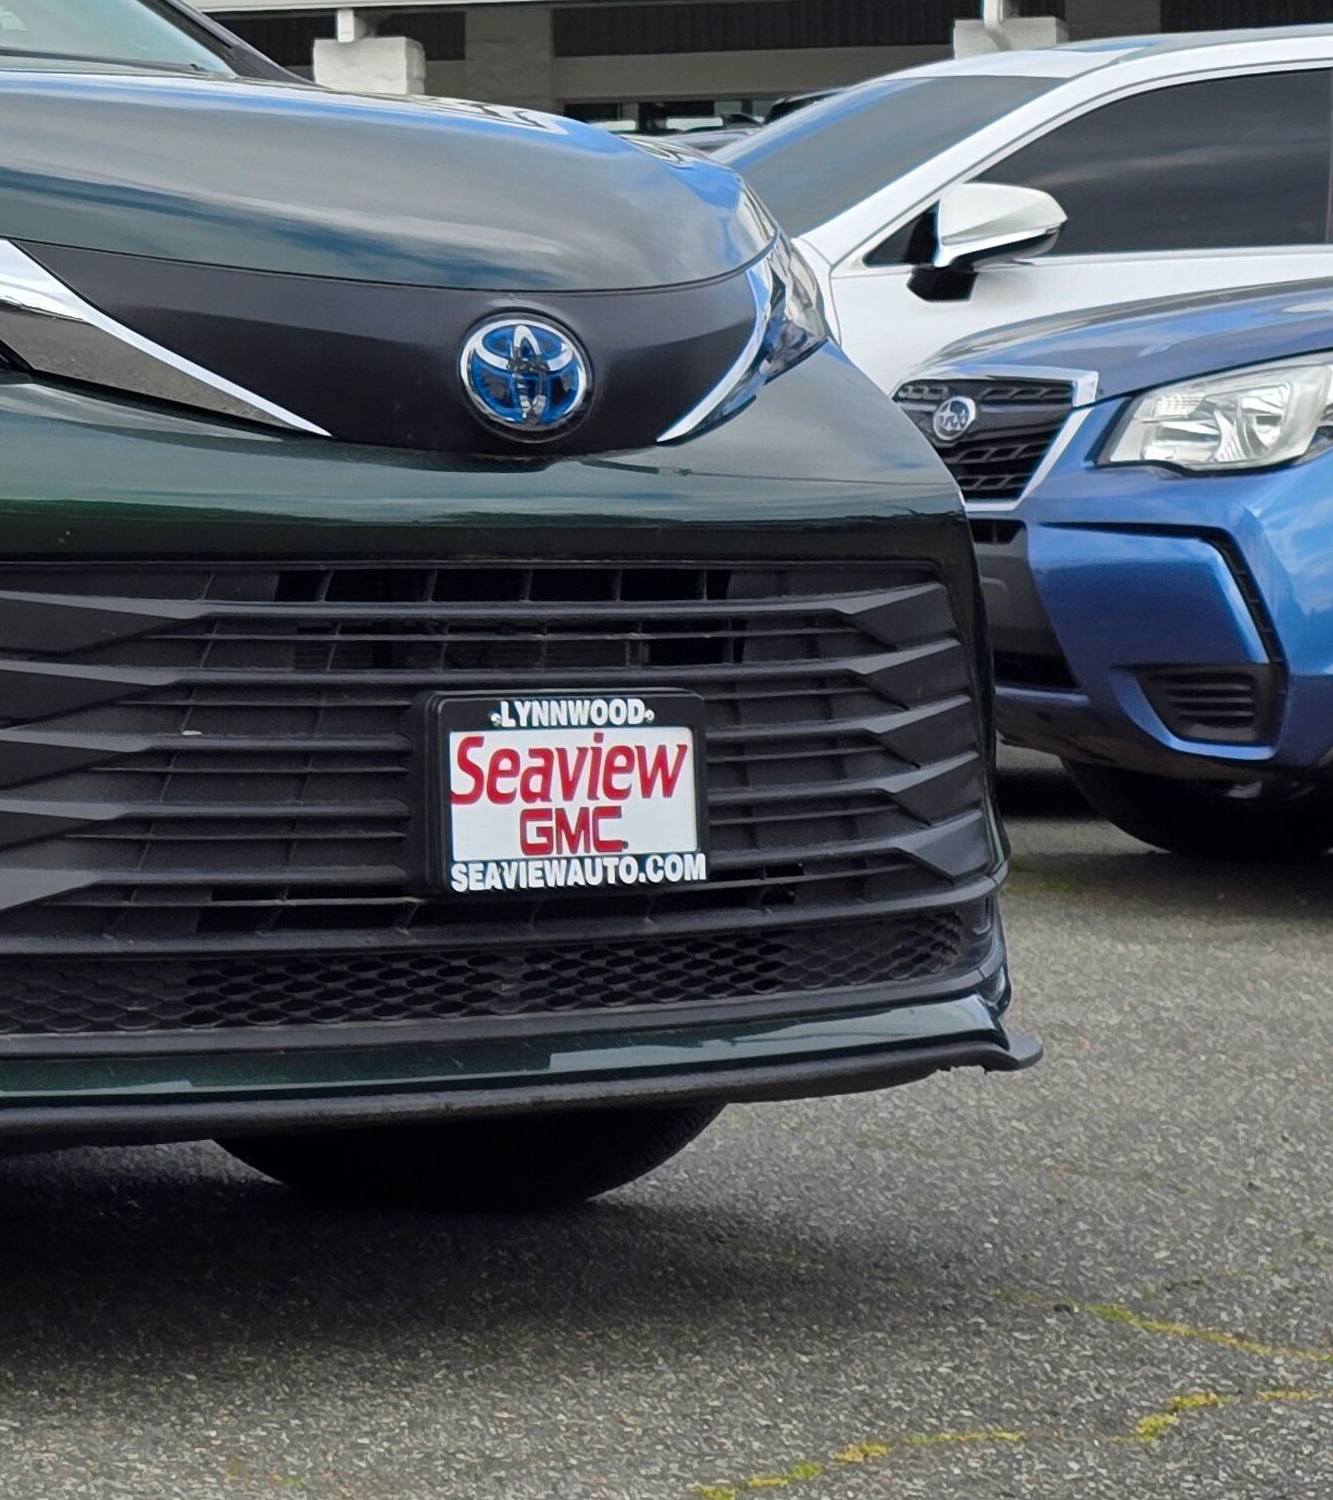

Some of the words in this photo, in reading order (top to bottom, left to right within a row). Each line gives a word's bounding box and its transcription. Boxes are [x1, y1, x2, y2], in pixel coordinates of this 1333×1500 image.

[500, 699, 646, 728] LYNNWOOD
[450, 731, 689, 805] Seaview
[519, 805, 624, 856] GMC
[449, 853, 707, 893] SEAVIEWAUTO.COM
